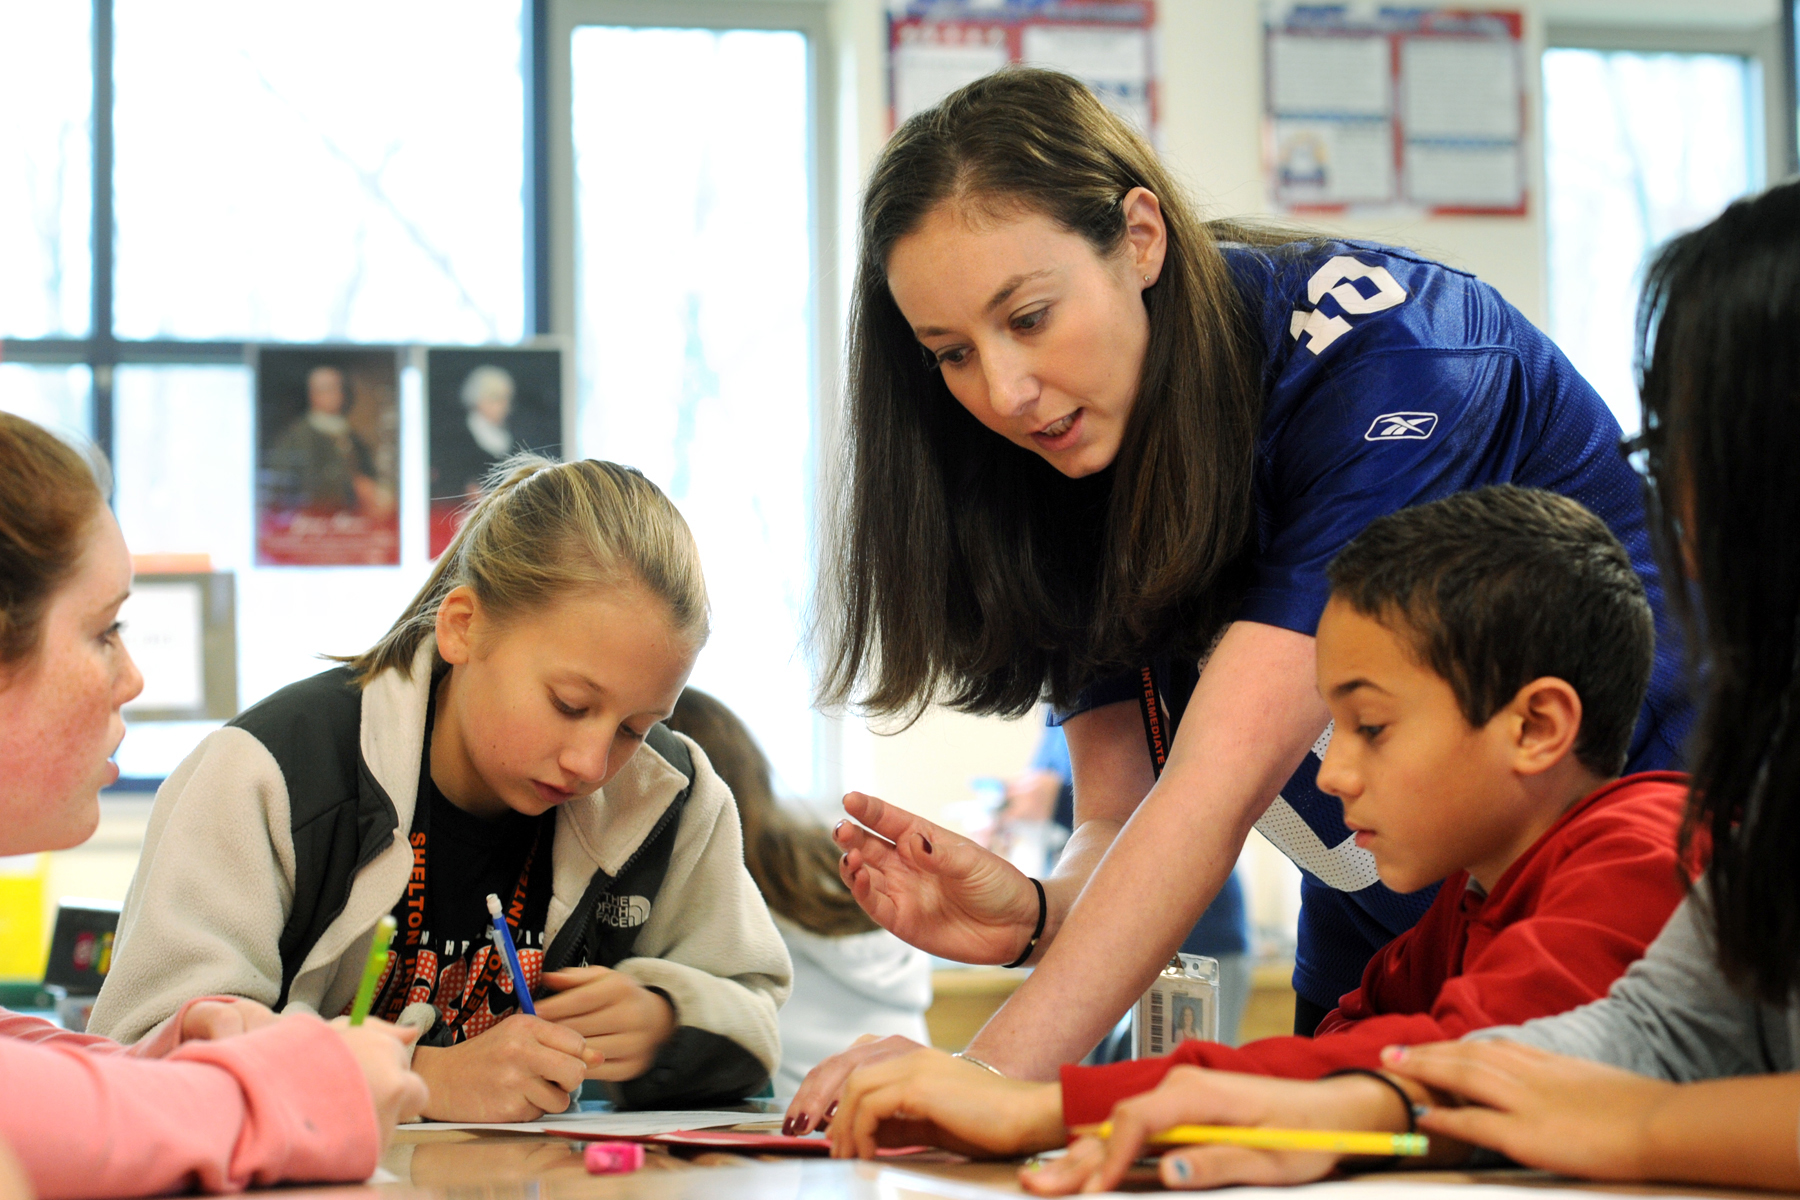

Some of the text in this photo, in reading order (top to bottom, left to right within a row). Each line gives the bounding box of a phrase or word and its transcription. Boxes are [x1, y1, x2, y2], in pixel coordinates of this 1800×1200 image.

[1290, 256, 1407, 356] 40
[1141, 667, 1166, 764] INTERMEDIATE
[406, 832, 426, 945] SHELTON
[596, 911, 629, 928] FACE
[601, 892, 629, 907] THE
